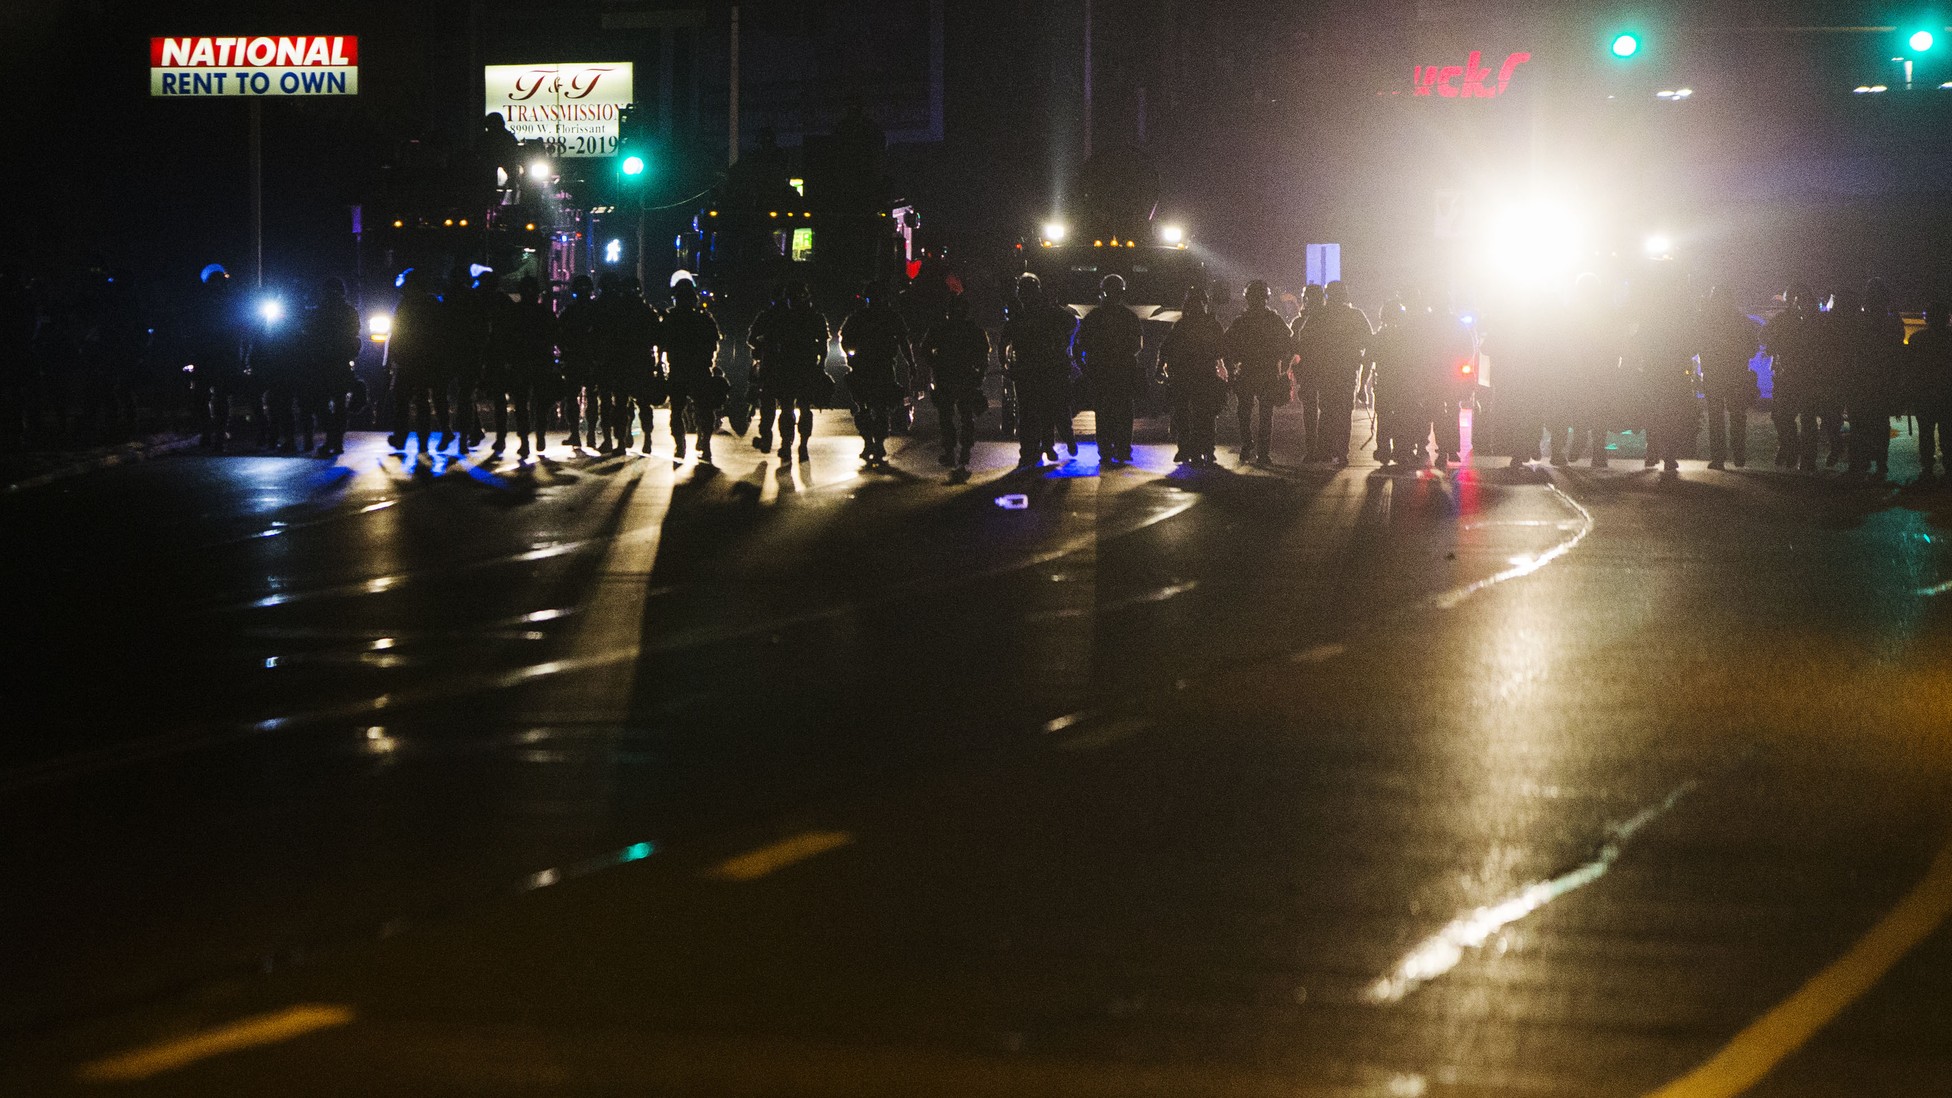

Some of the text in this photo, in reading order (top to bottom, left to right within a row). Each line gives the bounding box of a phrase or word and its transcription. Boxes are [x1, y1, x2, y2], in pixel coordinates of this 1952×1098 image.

[161, 36, 349, 67] NATIONAL
[162, 72, 346, 95] RENT TO OWN
[548, 76, 563, 93] &
[510, 124, 534, 134] 8990
[556, 123, 605, 134] Florissant
